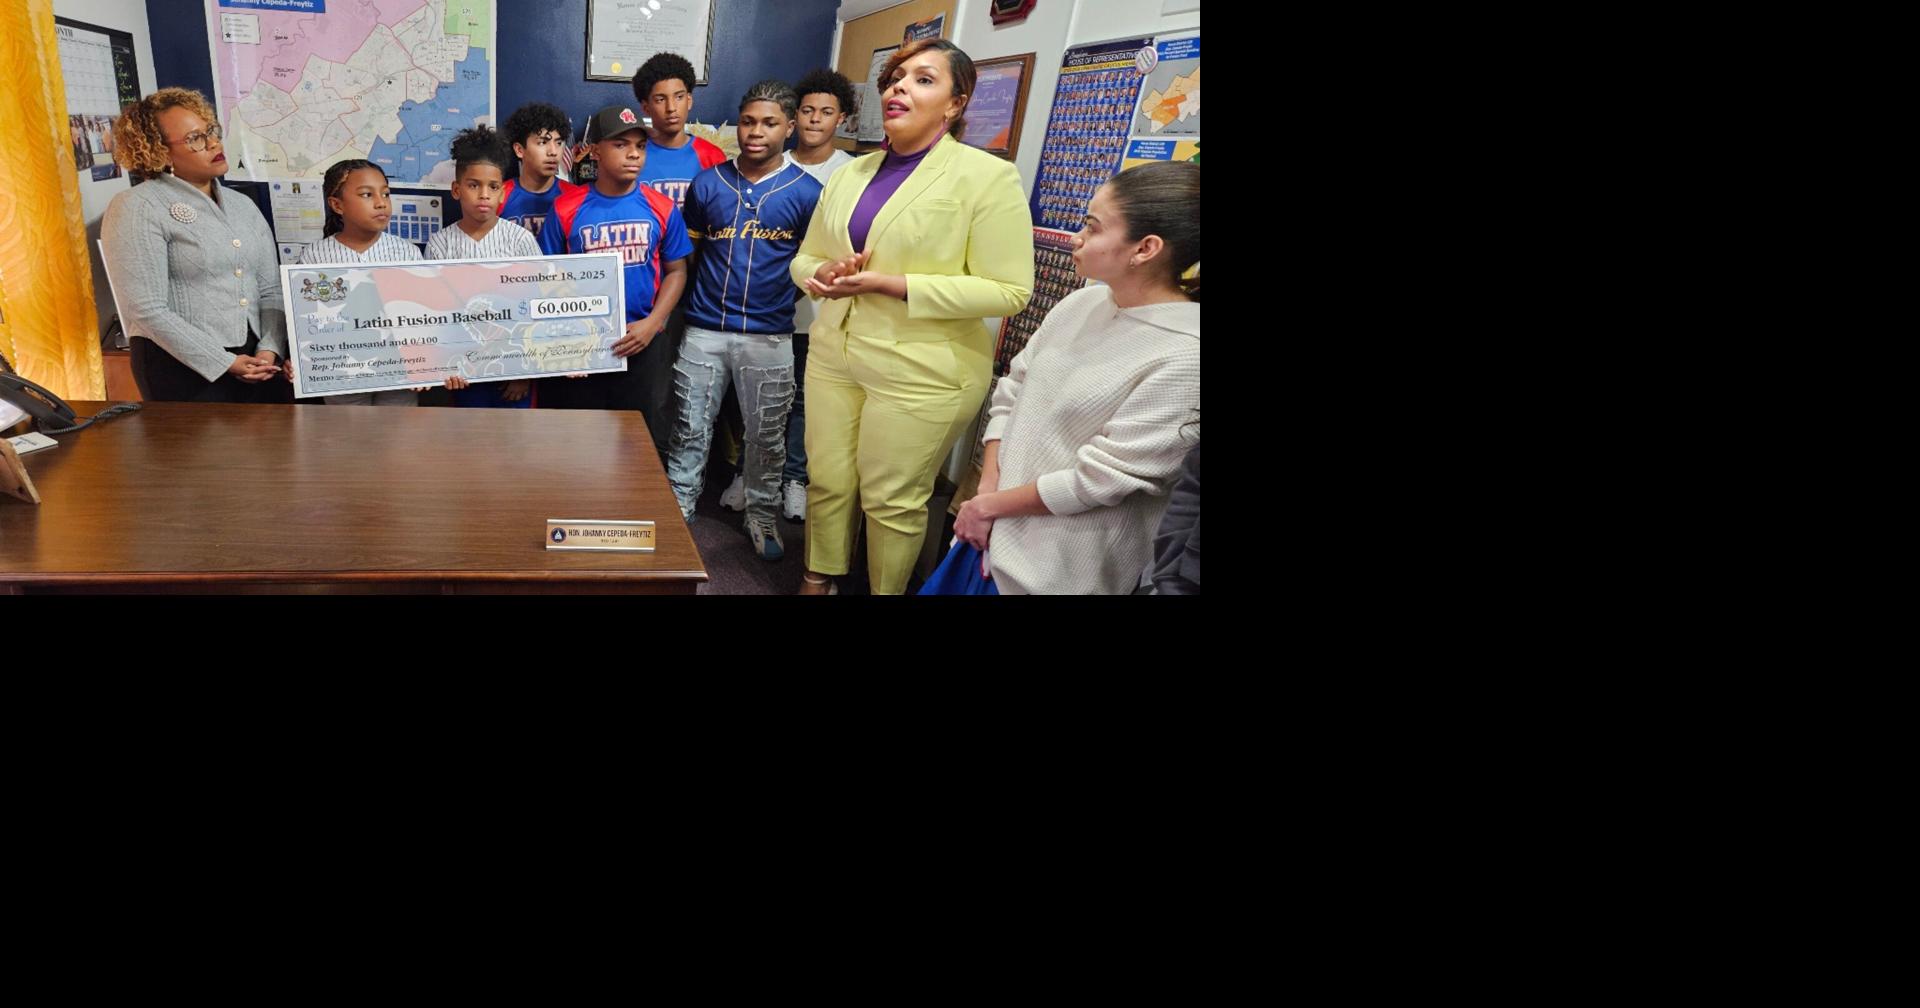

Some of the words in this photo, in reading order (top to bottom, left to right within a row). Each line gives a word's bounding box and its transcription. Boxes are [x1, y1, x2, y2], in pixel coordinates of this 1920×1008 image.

[582, 223, 650, 250] LATIN
[500, 272, 557, 284] December
[561, 272, 576, 282] 18,
[580, 270, 605, 281] 2025
[353, 316, 393, 329] Latin
[398, 313, 448, 327] Fusion
[452, 308, 512, 323] Baseball
[309, 343, 335, 353] Sixty
[339, 340, 386, 350] thousand
[389, 338, 408, 347] and
[410, 336, 438, 346] 0/100
[311, 364, 329, 372] Rep.
[330, 362, 365, 371] Johanny
[367, 356, 426, 367] Cepeda-Freytiz
[465, 349, 537, 363] Commonwealth
[539, 349, 548, 360] of
